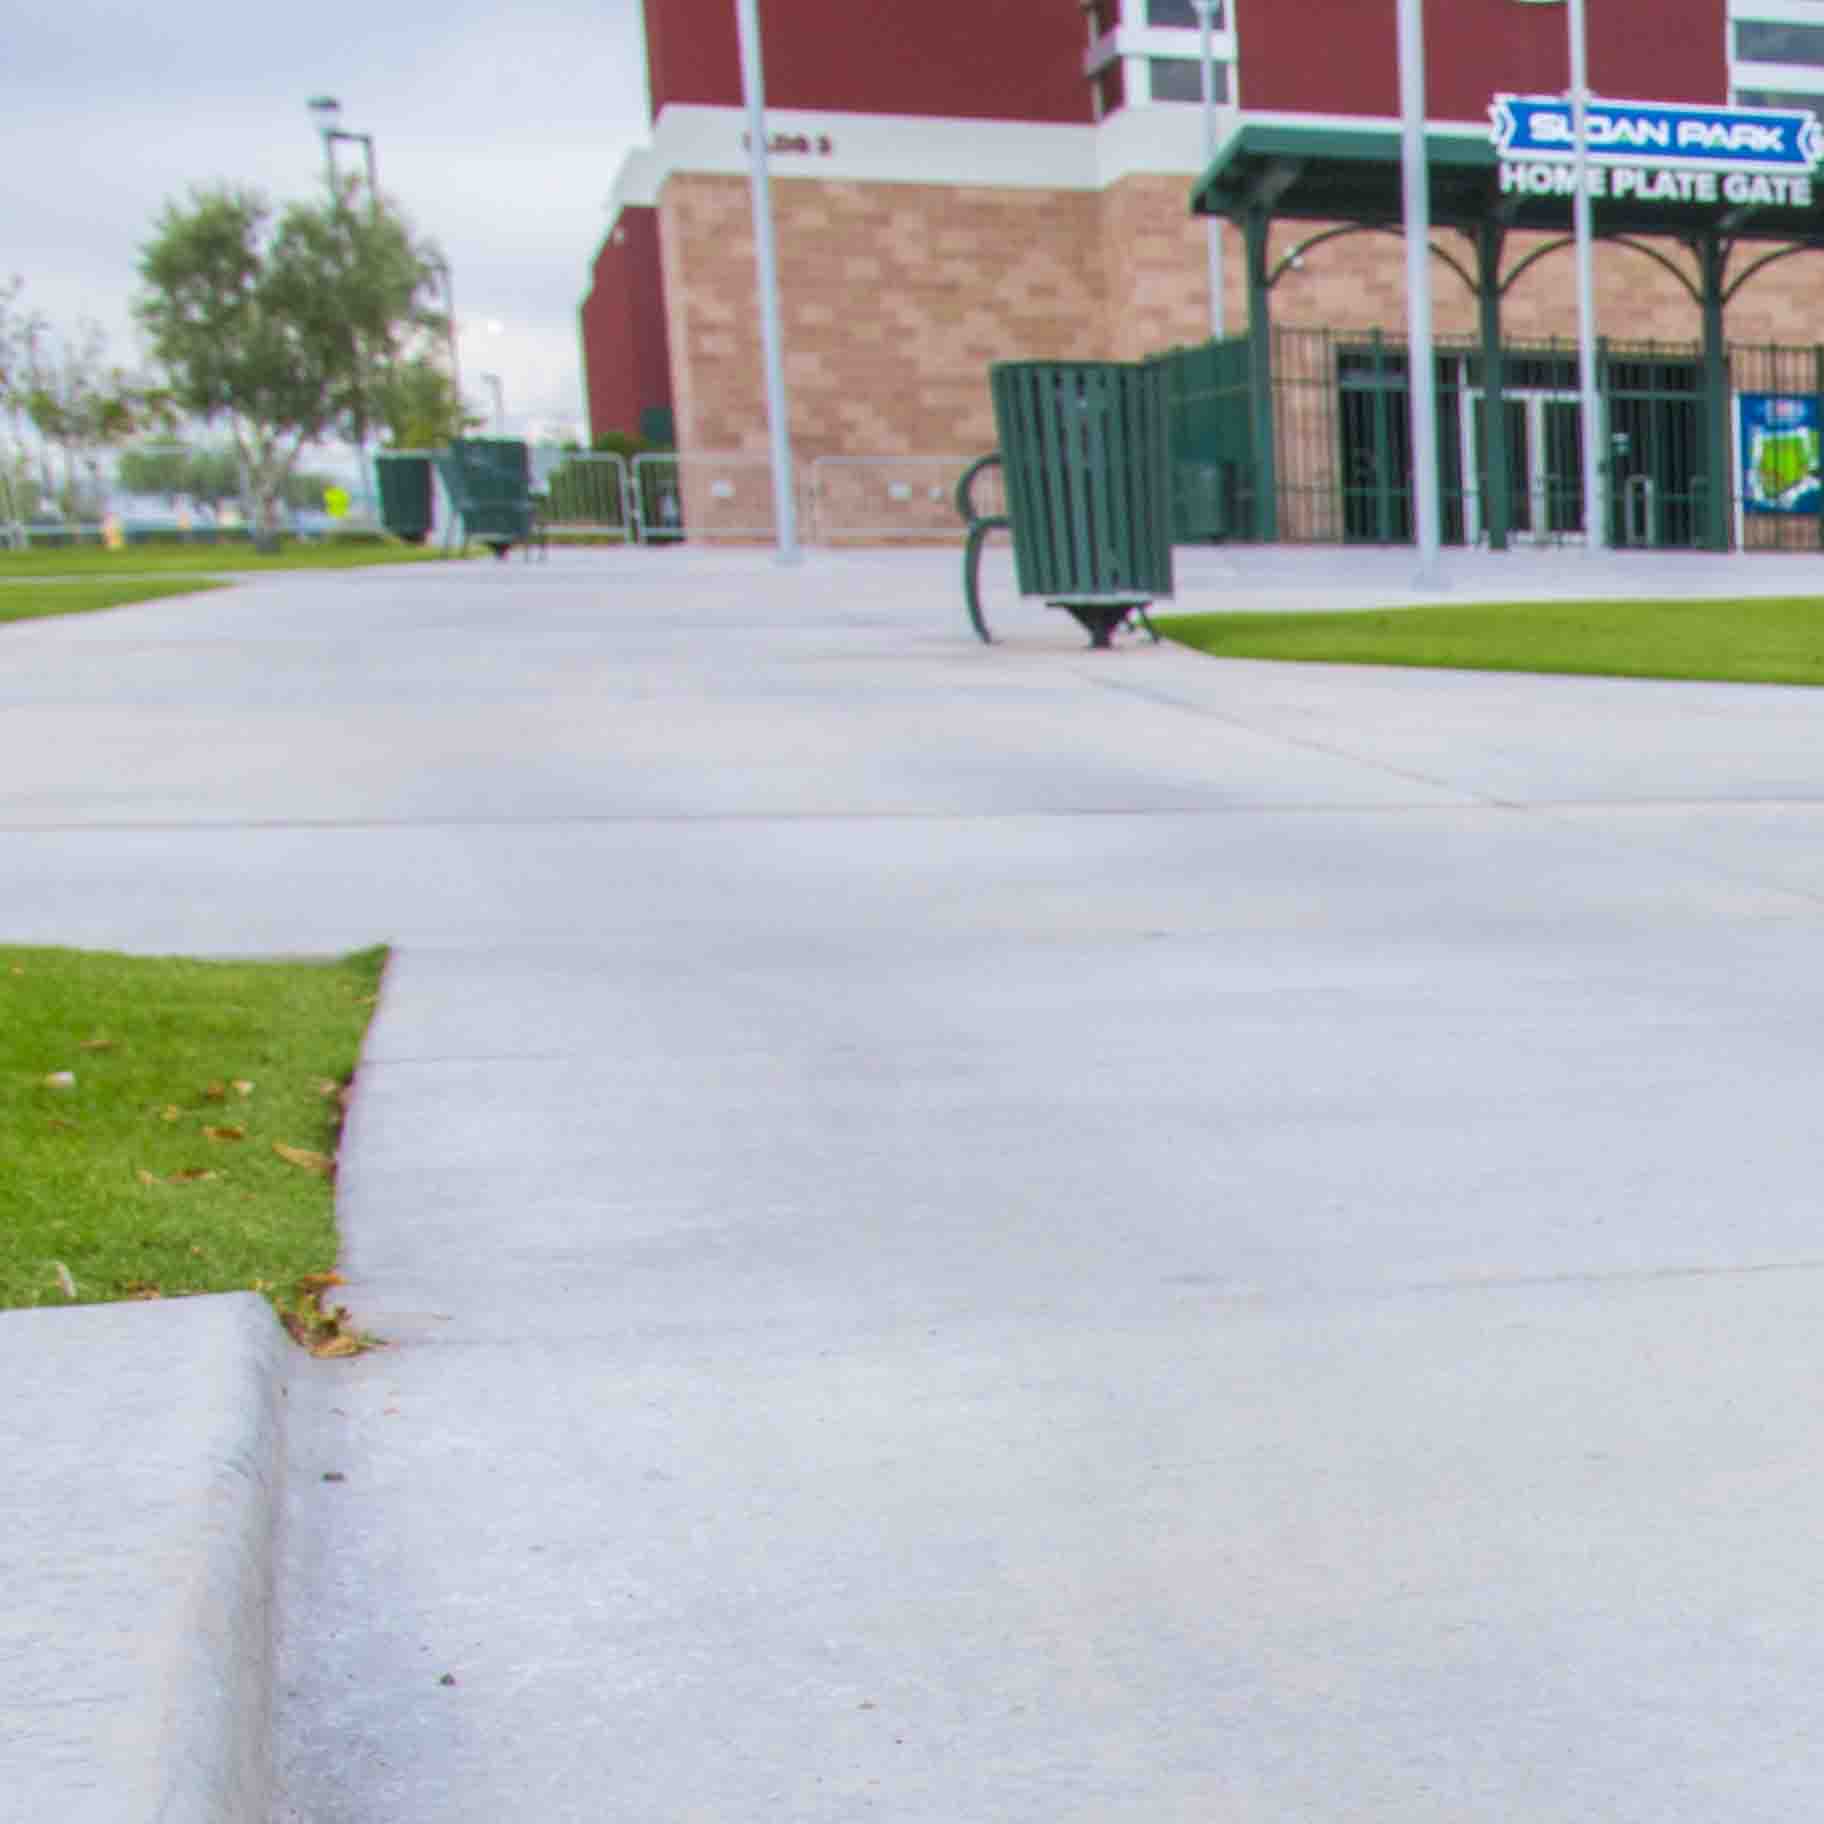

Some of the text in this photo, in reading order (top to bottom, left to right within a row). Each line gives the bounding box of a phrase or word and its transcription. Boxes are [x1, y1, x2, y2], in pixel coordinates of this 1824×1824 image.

[1529, 112, 1784, 152] SLOAN PARK
[1499, 160, 1812, 206] HOME PLATE GATE
